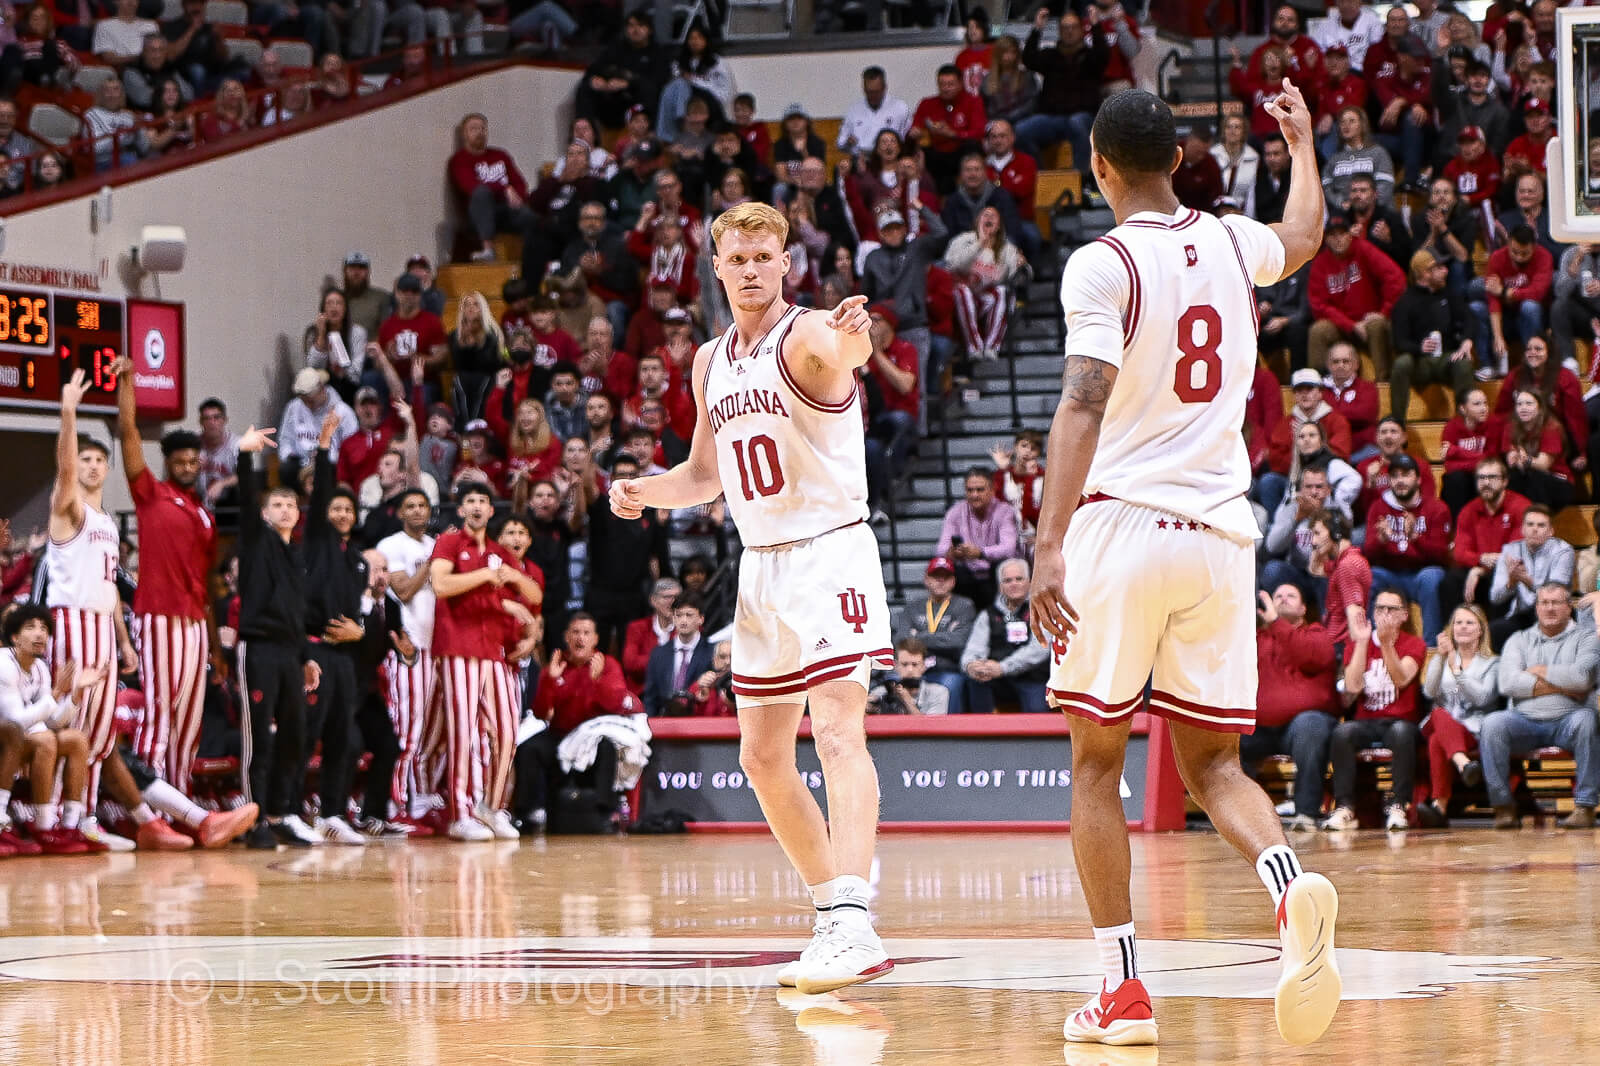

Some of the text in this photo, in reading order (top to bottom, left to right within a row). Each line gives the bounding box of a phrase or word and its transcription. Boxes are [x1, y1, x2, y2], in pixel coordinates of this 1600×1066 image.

[11, 264, 72, 287] ASSEMBLY
[73, 271, 99, 290] HALL
[1173, 304, 1222, 403] 8
[27, 361, 34, 388] 1
[710, 389, 789, 434] INDIANA
[732, 434, 784, 501] 10
[658, 771, 702, 790] YOU
[712, 771, 753, 789] GO
[902, 769, 1071, 788] YOU GOT THIS
